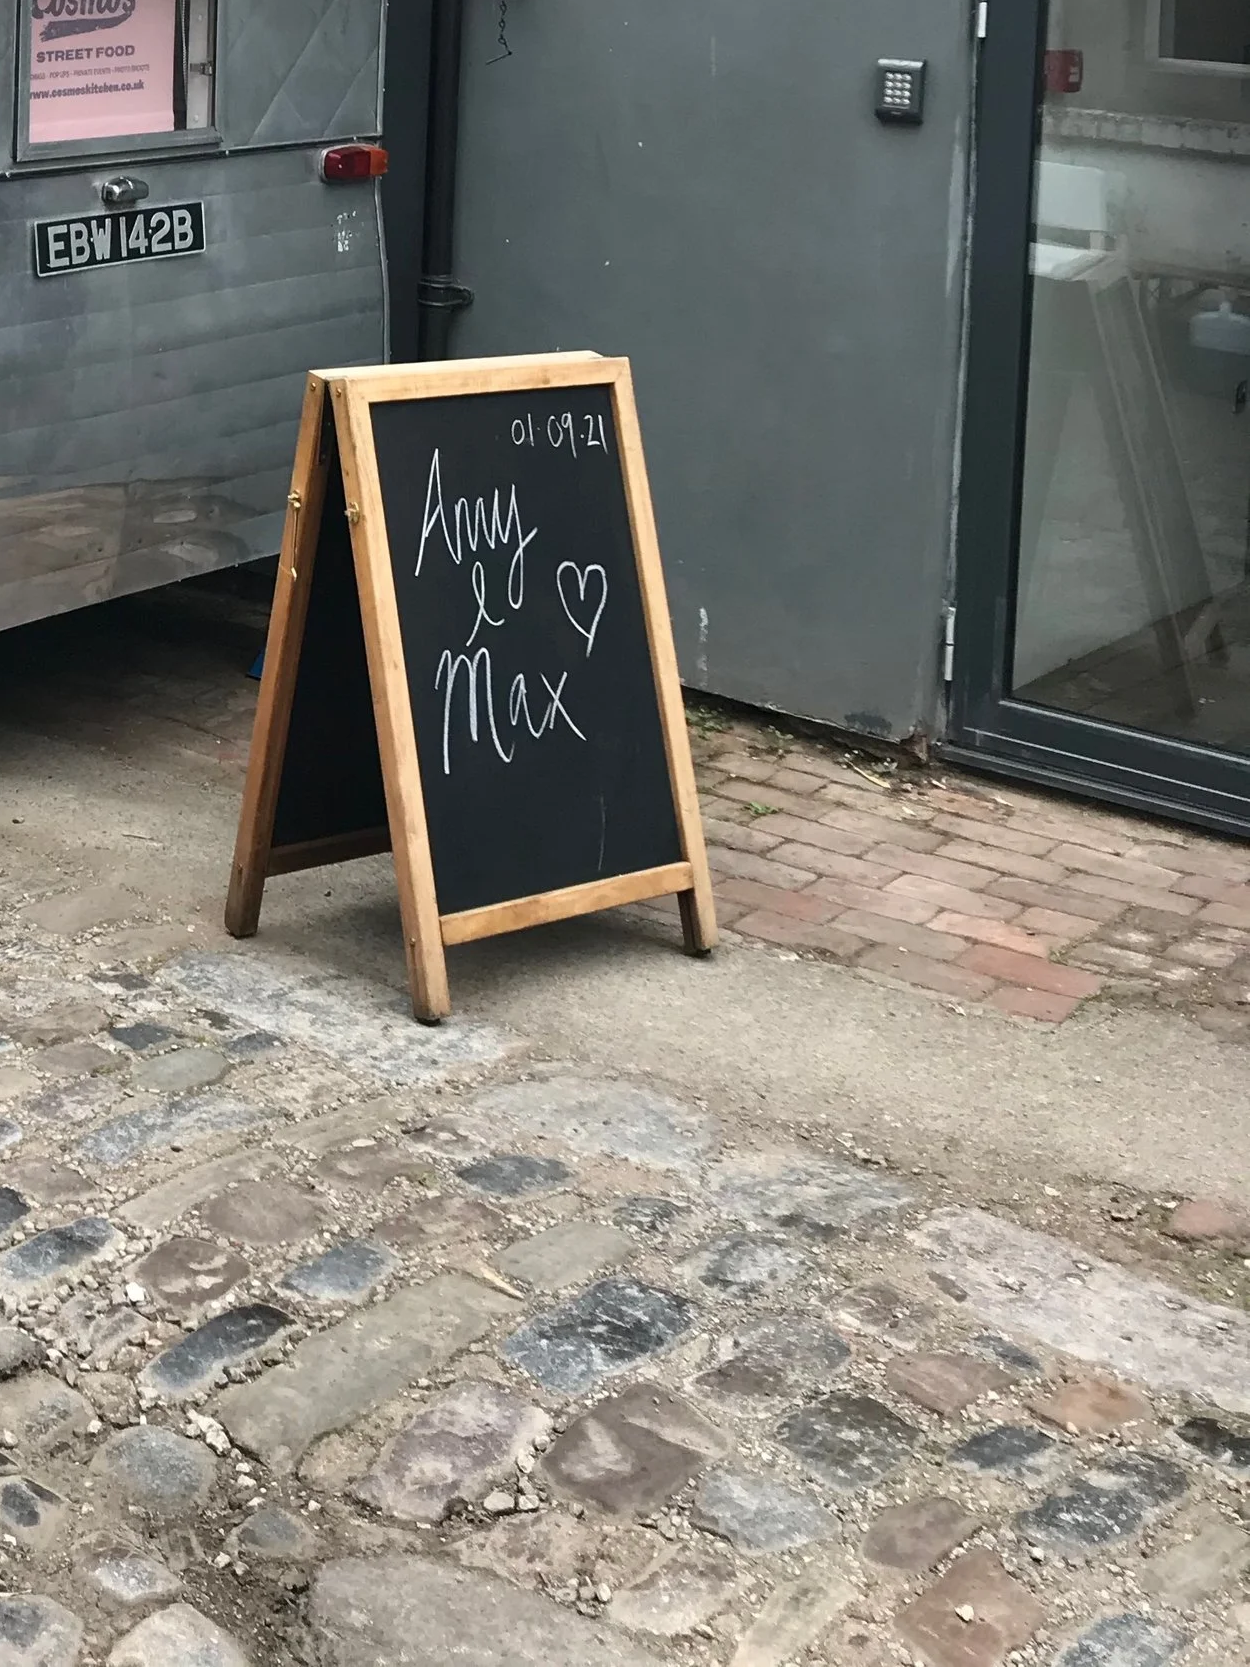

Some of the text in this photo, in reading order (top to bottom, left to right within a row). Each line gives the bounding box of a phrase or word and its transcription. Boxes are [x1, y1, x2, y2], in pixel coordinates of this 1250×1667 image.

[36, 45, 136, 63] STREET FOOD
[47, 209, 194, 268] EBW 142B
[415, 447, 539, 611] Amy
[434, 646, 587, 775] Max
